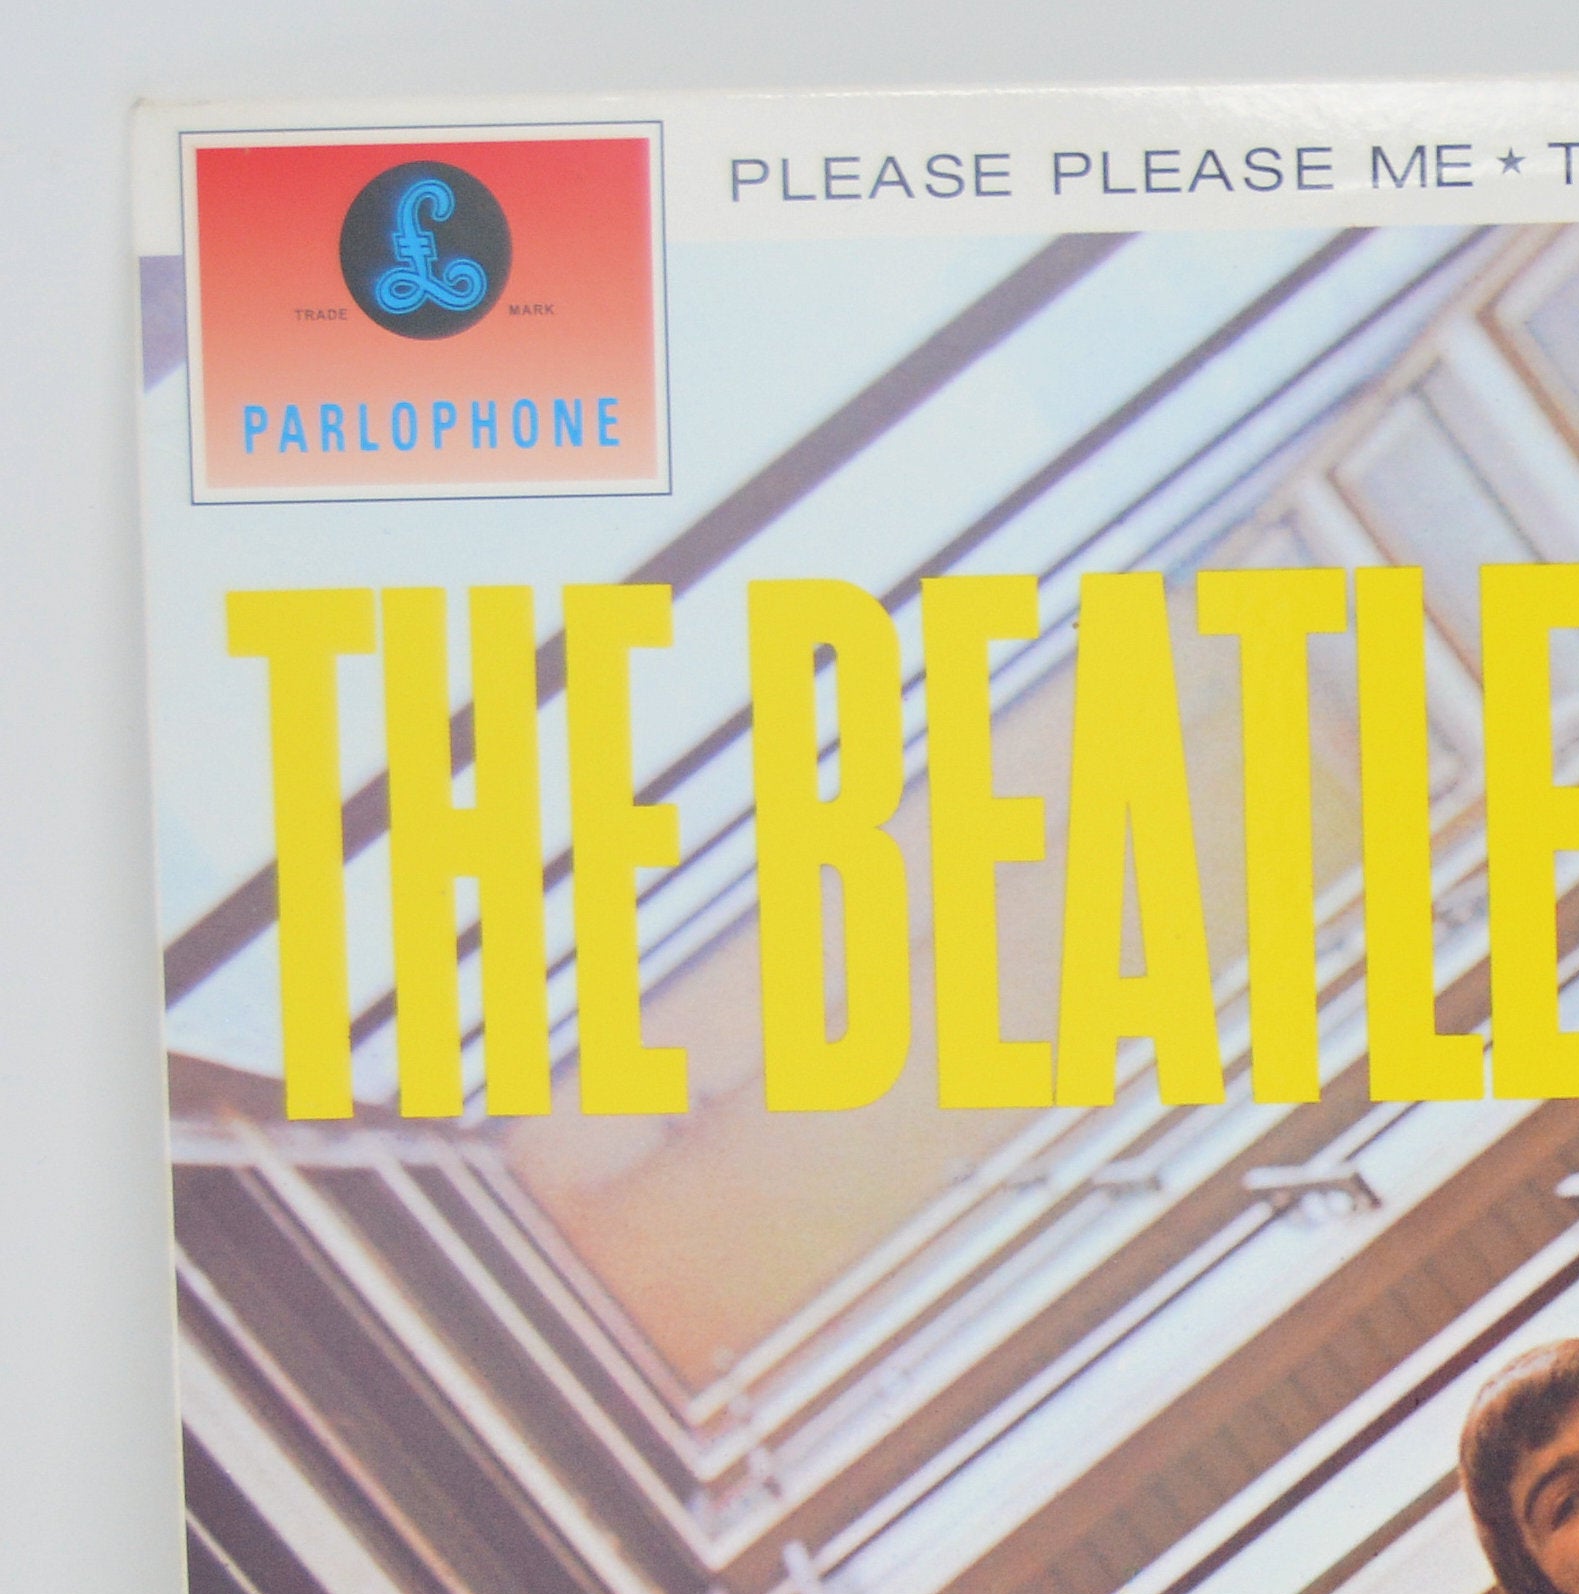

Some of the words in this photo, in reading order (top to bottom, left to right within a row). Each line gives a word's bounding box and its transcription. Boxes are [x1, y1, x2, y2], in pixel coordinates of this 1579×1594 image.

[731, 153, 1011, 201] PLEASE
[1053, 146, 1333, 195] PLEASE
[1371, 144, 1473, 188] ME
[294, 306, 349, 323] TRADE
[507, 301, 556, 317] MARK
[242, 396, 621, 455] PARLOPHONE
[227, 584, 687, 1120] THE
